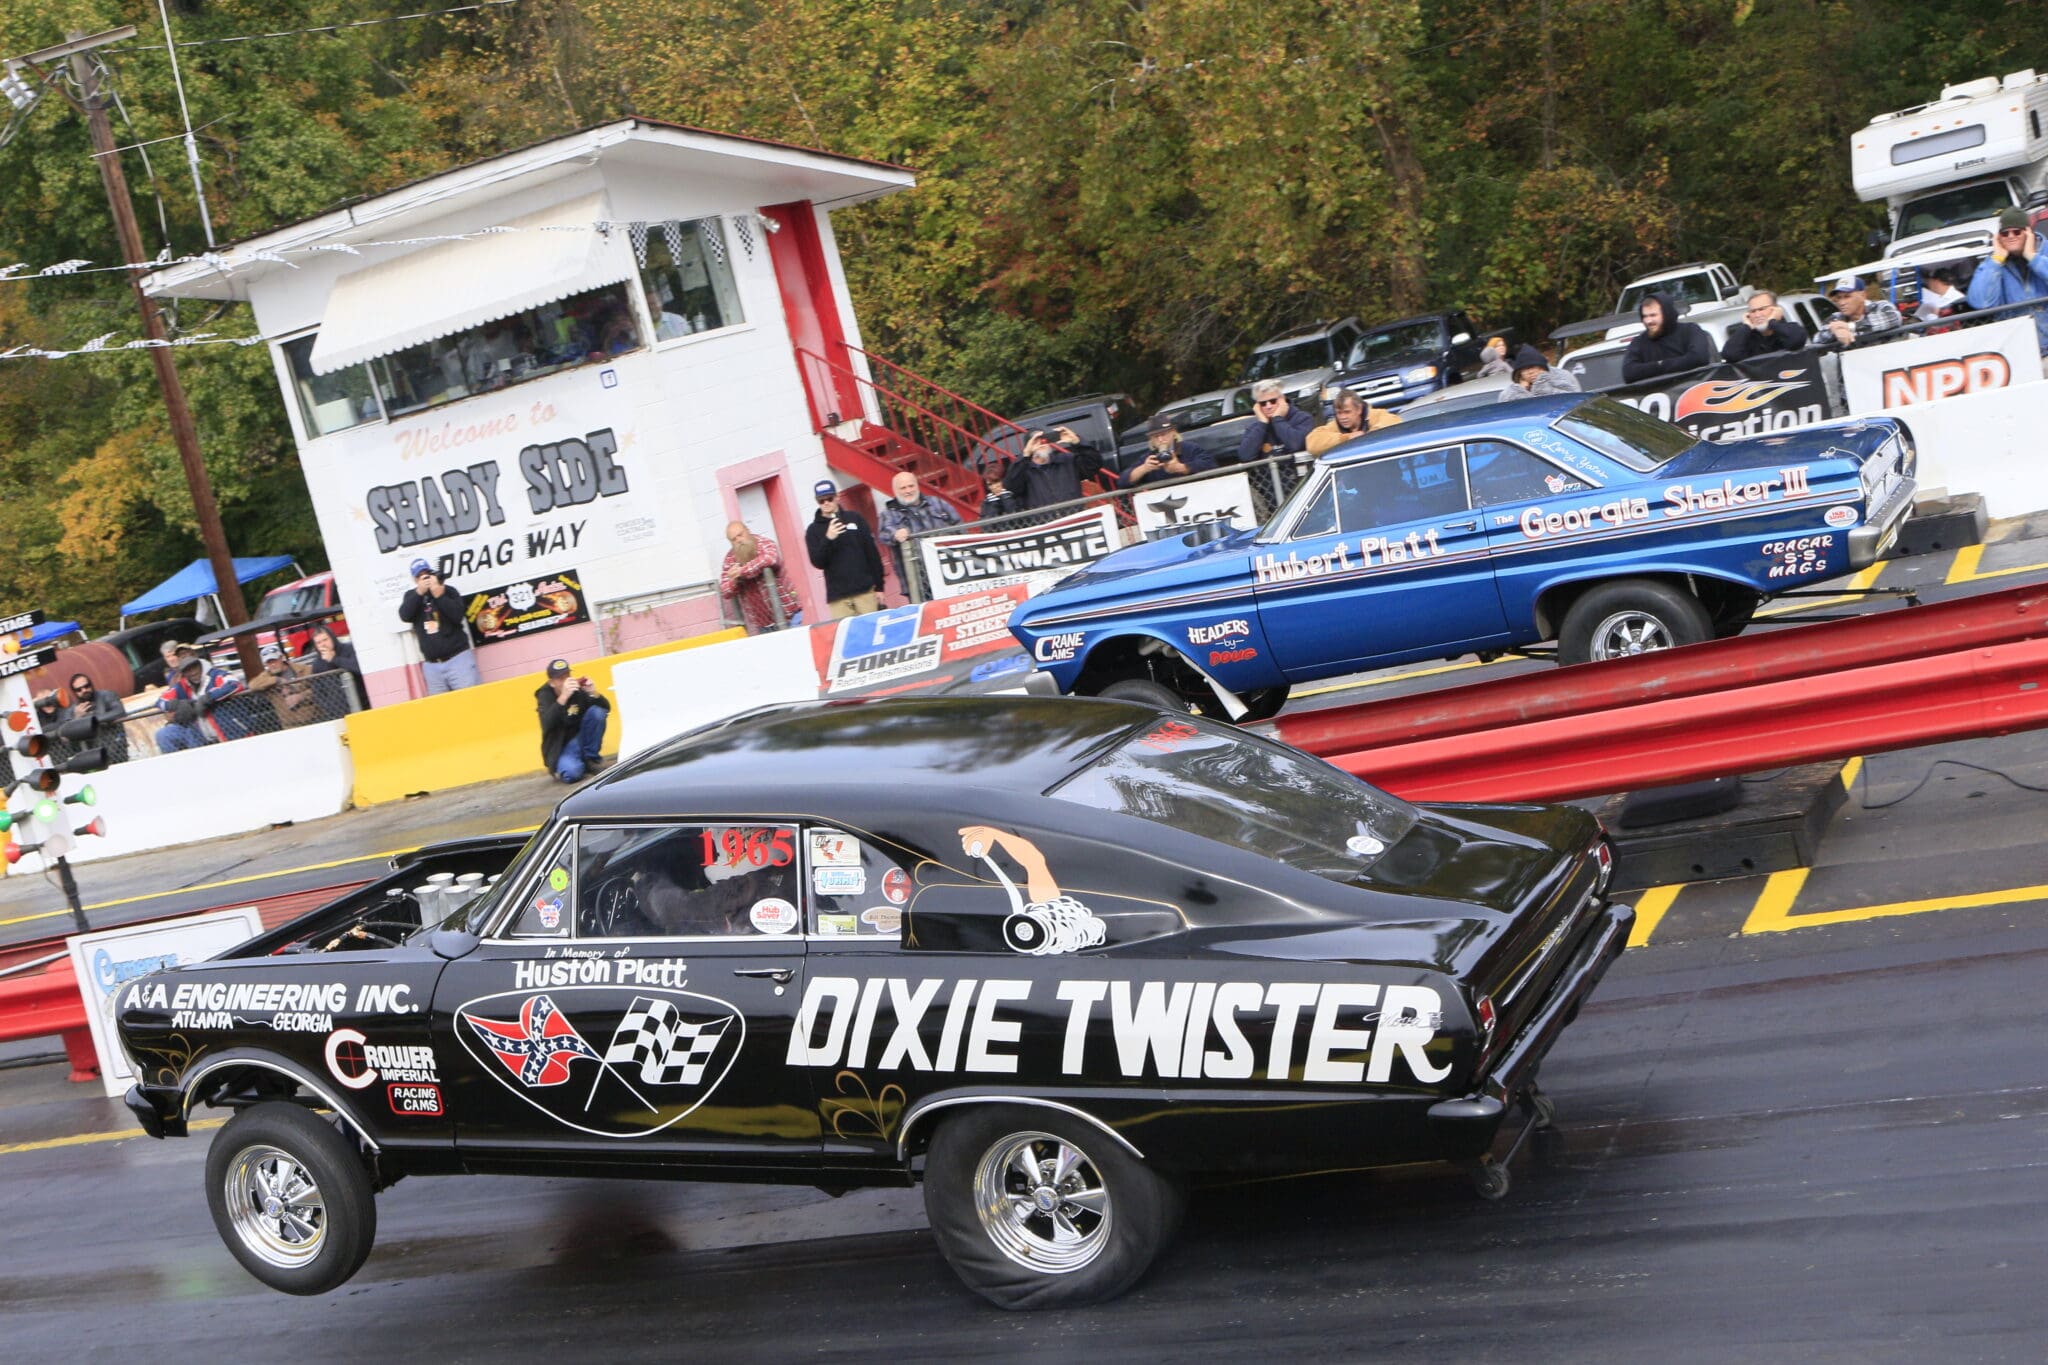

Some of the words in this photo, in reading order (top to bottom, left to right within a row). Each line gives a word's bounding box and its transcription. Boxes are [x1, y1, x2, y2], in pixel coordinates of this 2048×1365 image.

[1882, 352, 2011, 409] NPD
[394, 412, 518, 460] Welcome
[529, 401, 557, 424] to
[367, 460, 505, 553] SHADY
[519, 427, 629, 515] SIDE
[1520, 498, 1650, 538] Georgia
[1663, 478, 1782, 518] Shaker
[1778, 465, 1811, 498] III
[1493, 513, 1514, 526] The
[434, 539, 513, 580] DRAG
[525, 520, 587, 559] WAY
[938, 525, 1110, 580] ULTIMATE
[1254, 541, 1354, 584] Hubert
[1360, 528, 1445, 567] Platt
[1762, 535, 1833, 555] CRAGAR
[1784, 549, 1817, 564] S-S
[1768, 560, 1827, 578] MAGS
[1034, 632, 1085, 662] CRANE
[1188, 619, 1249, 645] HEADERS
[1224, 638, 1236, 650] by
[0, 655, 40, 676] TAGE
[838, 640, 937, 679] FORCE
[1208, 647, 1258, 667] DOUG
[699, 828, 795, 868] 1965
[545, 946, 556, 959] In
[561, 947, 605, 961] Memory
[614, 946, 630, 959] of
[512, 958, 610, 989] Huston
[616, 958, 688, 989] Platt
[124, 981, 168, 1010] A&A
[171, 983, 347, 1013] ENGINEERING
[355, 984, 420, 1015] INC.
[172, 1010, 234, 1031] ATLANTA
[272, 1012, 333, 1033] GEORGIA
[785, 976, 1022, 1074] DIXIE
[1054, 980, 1454, 1084] TWISTER
[324, 1027, 437, 1089] CROWER
[380, 1068, 441, 1083] IMPERIAL
[393, 1087, 436, 1100] RACING
[403, 1099, 439, 1112] CAMS
